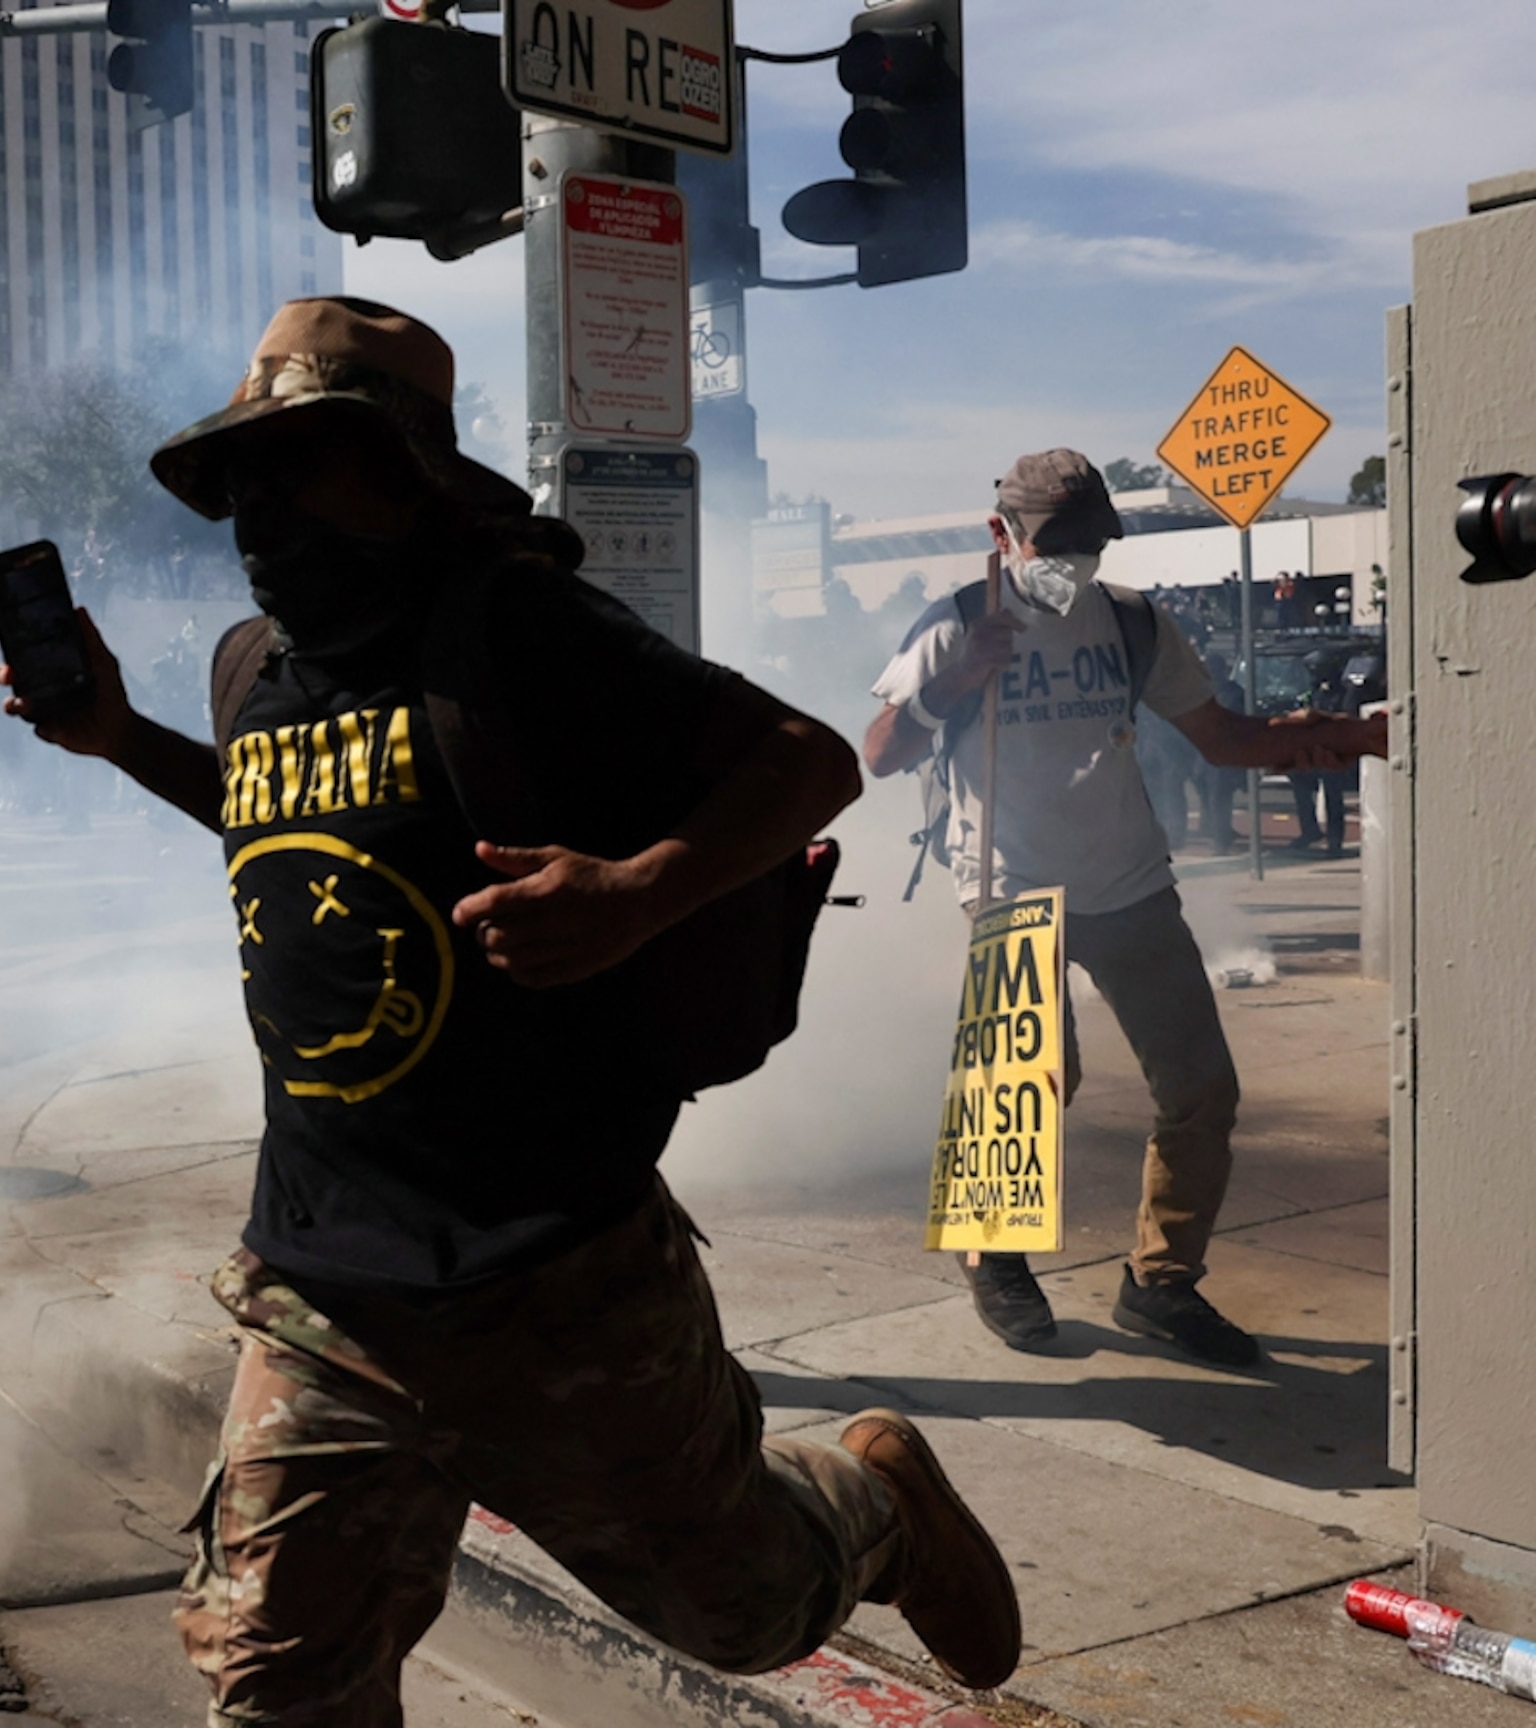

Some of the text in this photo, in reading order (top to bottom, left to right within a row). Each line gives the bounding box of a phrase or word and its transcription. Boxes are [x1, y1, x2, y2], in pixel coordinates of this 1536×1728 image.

[531, 1, 680, 114] ON RE
[681, 55, 720, 89] OGRO
[681, 82, 720, 114] OZER
[587, 192, 615, 208] ZONA
[589, 207, 603, 219] DE
[1209, 378, 1269, 407] THRU
[1192, 404, 1289, 440] TRAFFIC
[1195, 436, 1287, 470] MERGE
[1213, 469, 1273, 497] LEFT
[220, 706, 420, 829] IRVANA
[941, 1081, 1042, 1140] US INT
[934, 1136, 1043, 1179] YOU DRA
[1009, 1179, 1045, 1208] WE
[1006, 1213, 1044, 1227] TRUMP
